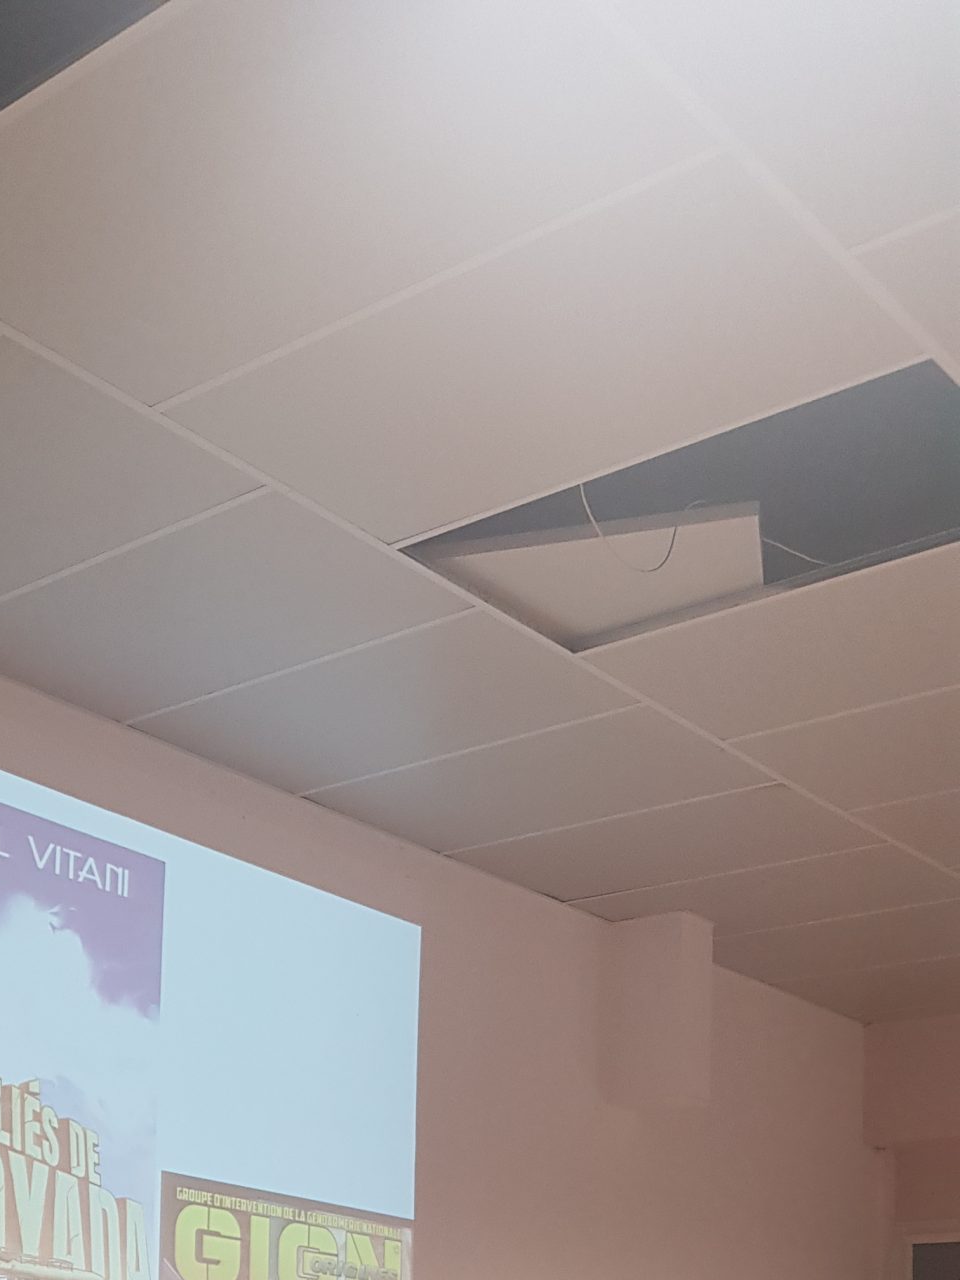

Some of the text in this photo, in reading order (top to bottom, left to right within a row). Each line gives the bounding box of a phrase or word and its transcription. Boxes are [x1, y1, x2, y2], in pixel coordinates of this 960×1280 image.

[28, 835, 130, 898] VITANI
[69, 1118, 102, 1187] DE
[176, 1187, 214, 1206] GROUPE
